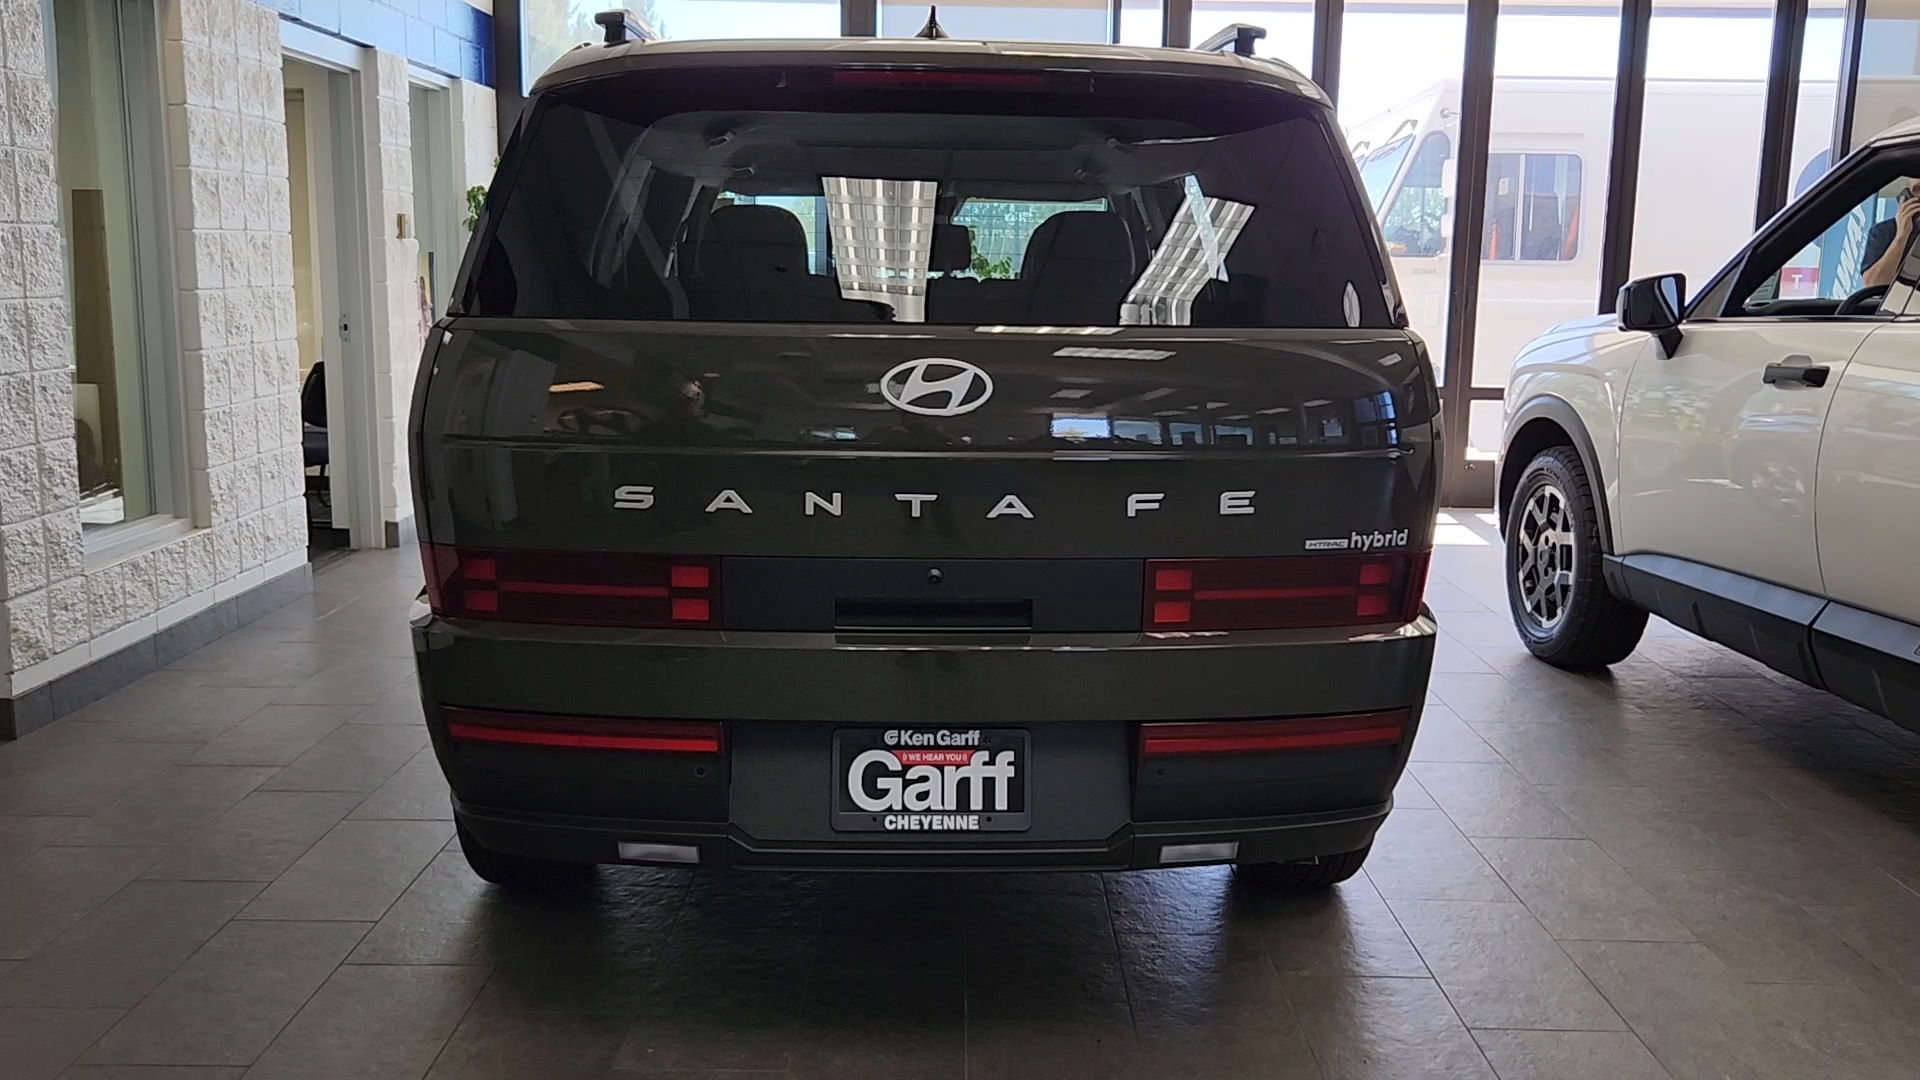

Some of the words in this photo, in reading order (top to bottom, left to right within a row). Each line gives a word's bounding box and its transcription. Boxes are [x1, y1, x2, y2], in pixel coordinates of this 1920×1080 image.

[613, 485, 1035, 519] SANTA
[1127, 490, 1257, 518] FE
[1350, 529, 1409, 551] hybrid
[900, 729, 935, 746] Ken
[936, 729, 981, 746] Garff
[908, 753, 921, 761] WE
[922, 753, 945, 761] HEAR
[945, 753, 962, 761] YOU
[848, 749, 1015, 812] Garff
[884, 815, 980, 830] CHEYENNE
